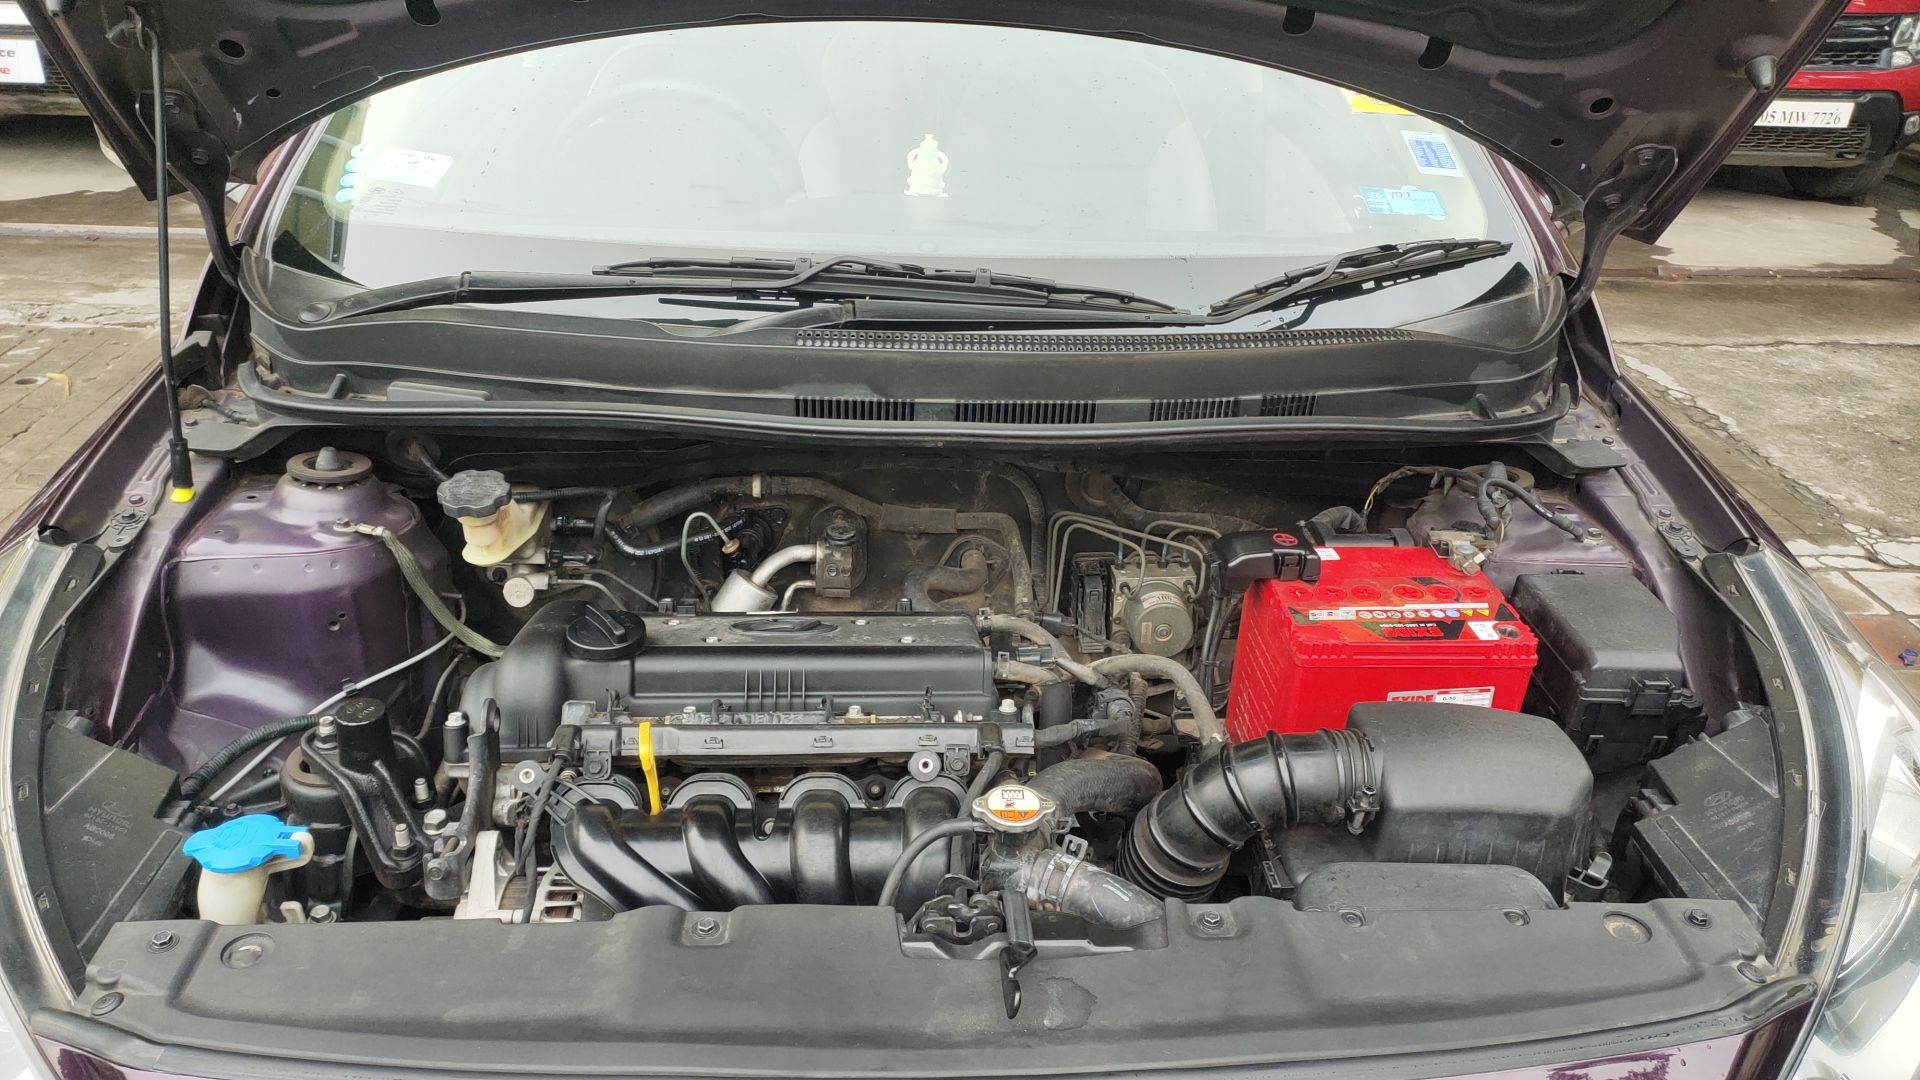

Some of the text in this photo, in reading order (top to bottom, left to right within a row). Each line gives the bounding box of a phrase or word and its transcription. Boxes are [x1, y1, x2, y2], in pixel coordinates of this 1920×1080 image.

[1779, 110, 1809, 124] MW
[1811, 111, 1841, 126] 7726
[1381, 627, 1444, 638] EXIDE
